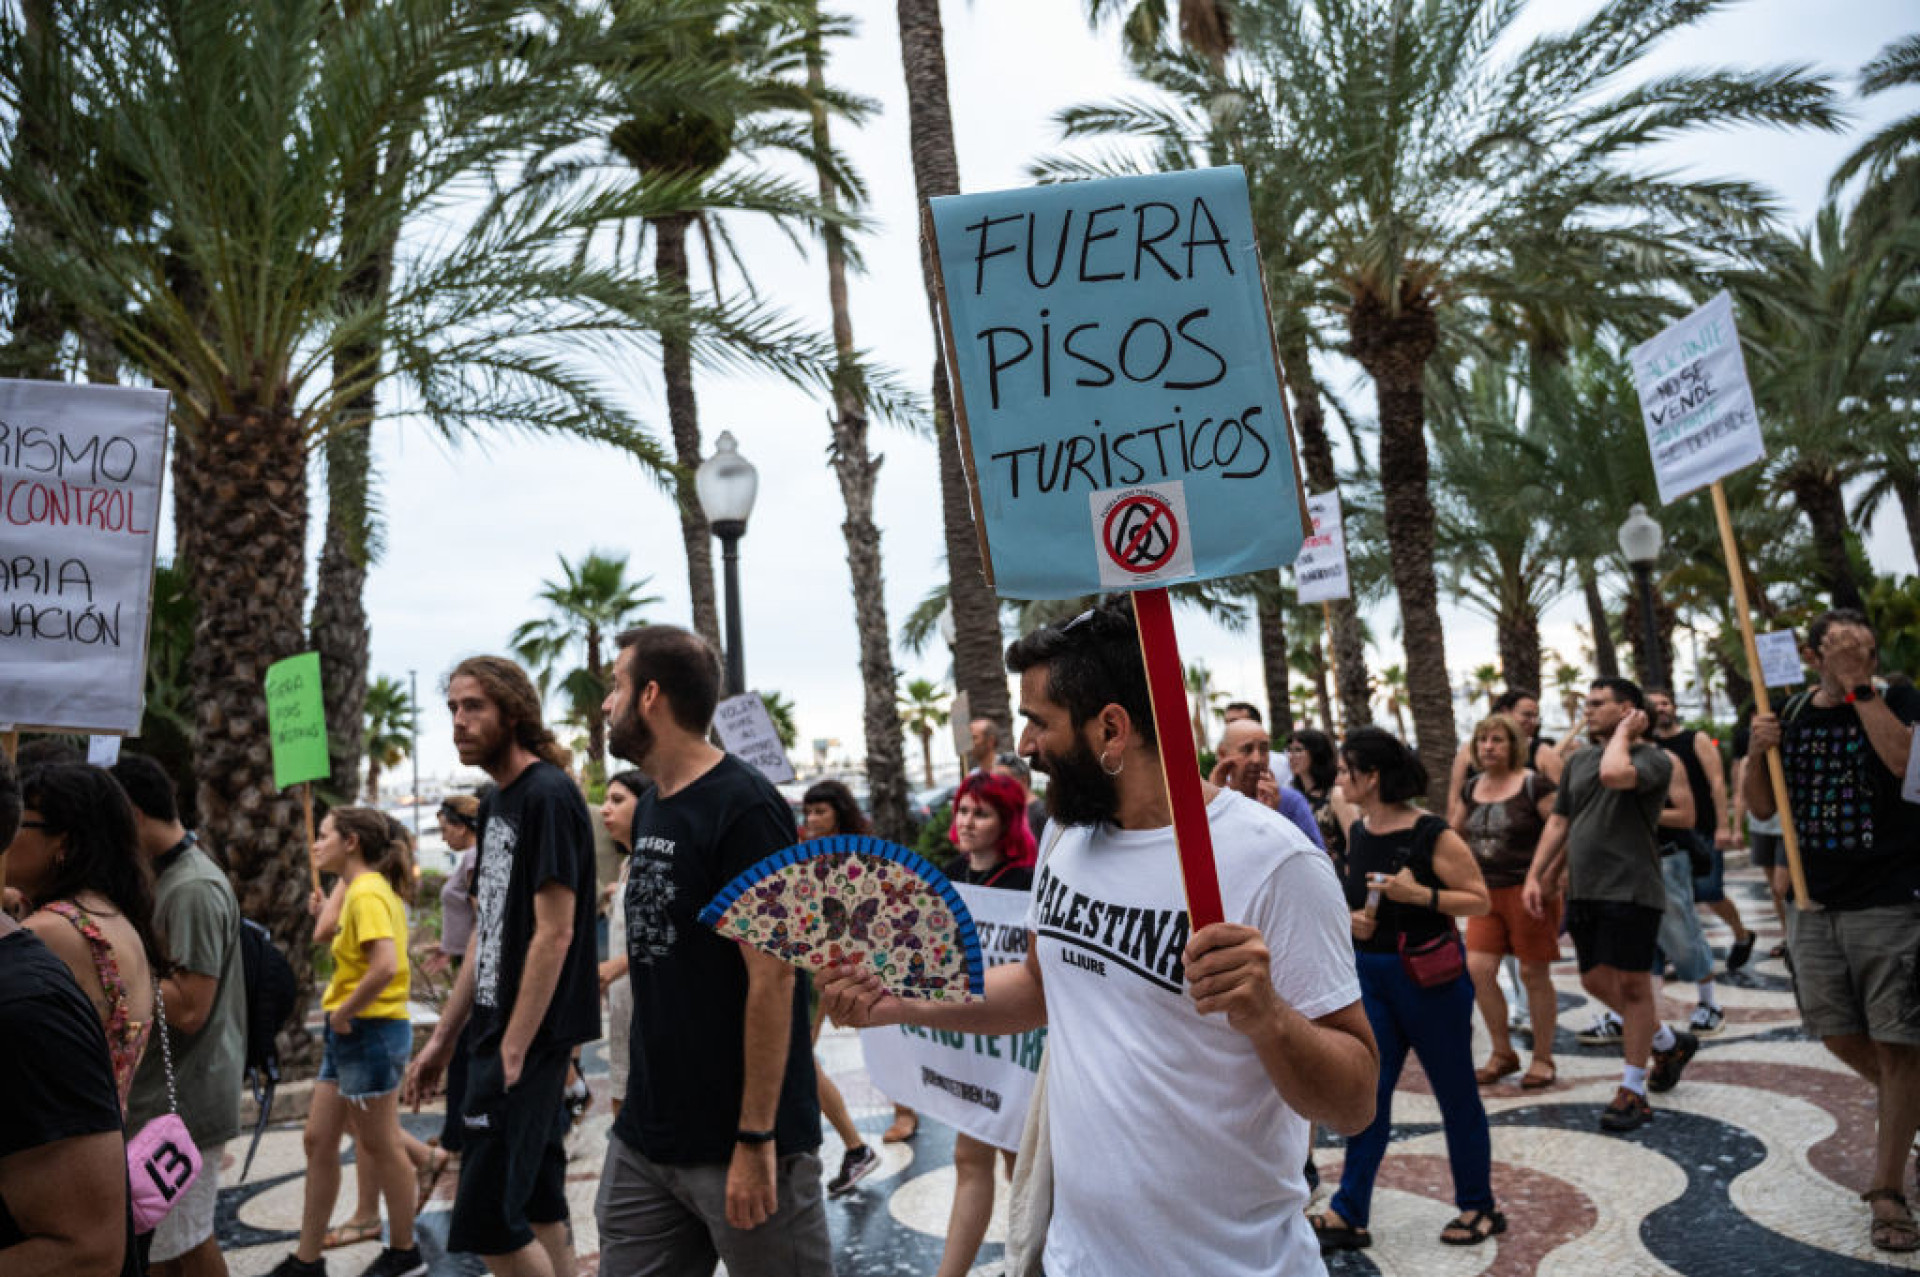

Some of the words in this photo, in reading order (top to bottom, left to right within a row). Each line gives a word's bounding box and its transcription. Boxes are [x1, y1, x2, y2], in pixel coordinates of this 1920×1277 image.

[965, 196, 1235, 295] FUERA
[976, 308, 1227, 410] PISOS
[991, 405, 1270, 499] TURISTICOS
[7, 479, 151, 535] CONTROL
[1036, 864, 1191, 986] PALESTINA
[1062, 948, 1107, 977] LLIURE
